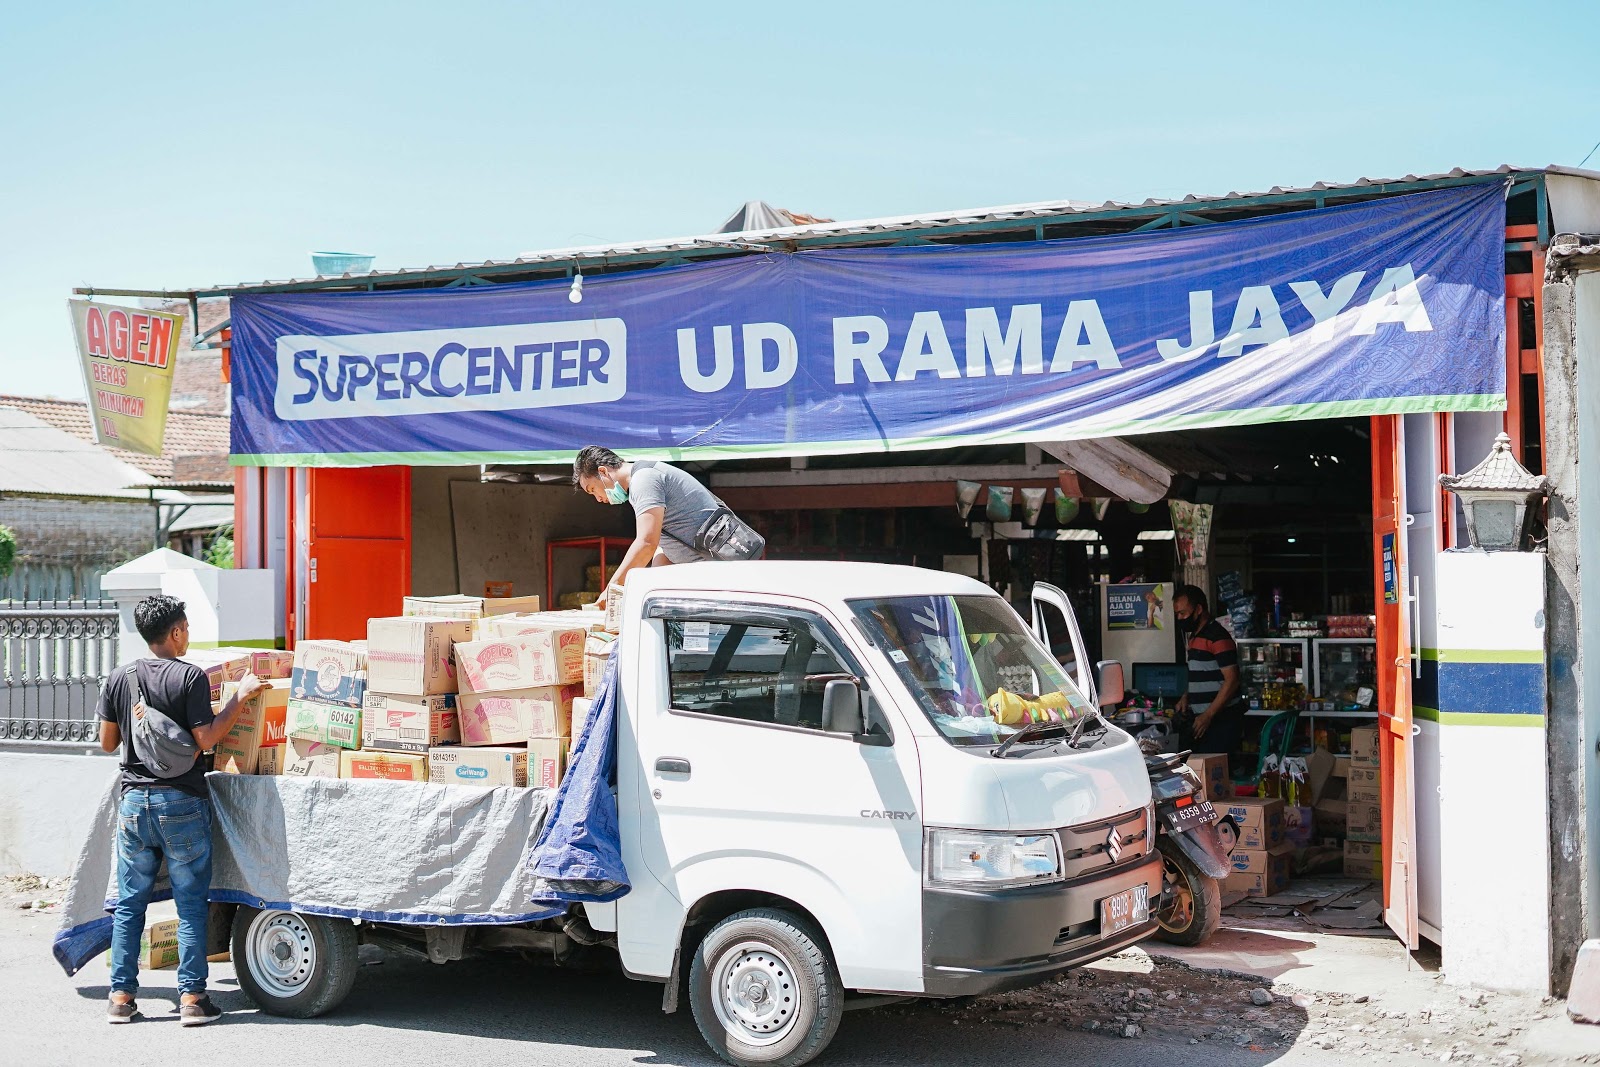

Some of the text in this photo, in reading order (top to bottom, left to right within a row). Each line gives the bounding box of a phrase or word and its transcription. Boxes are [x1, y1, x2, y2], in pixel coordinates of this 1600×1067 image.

[677, 263, 1433, 393] UD RAMA JAYA
[86, 307, 173, 369] AGEN
[91, 361, 127, 388] BERAS
[292, 338, 611, 405] SUPERCENTER
[96, 390, 144, 418] MINUMAN
[102, 416, 119, 440] DLL
[1109, 595, 1141, 603] BELANJA
[330, 710, 354, 725] 60142
[366, 732, 372, 742] 8
[432, 753, 458, 762] 68143151
[286, 760, 315, 776] Jaz1
[543, 759, 553, 788] NutriSa
[860, 809, 916, 820] CARRY
[1169, 801, 1213, 824] W 6359 UD
[1227, 807, 1247, 815] AQUA
[1231, 854, 1250, 863] AQUA
